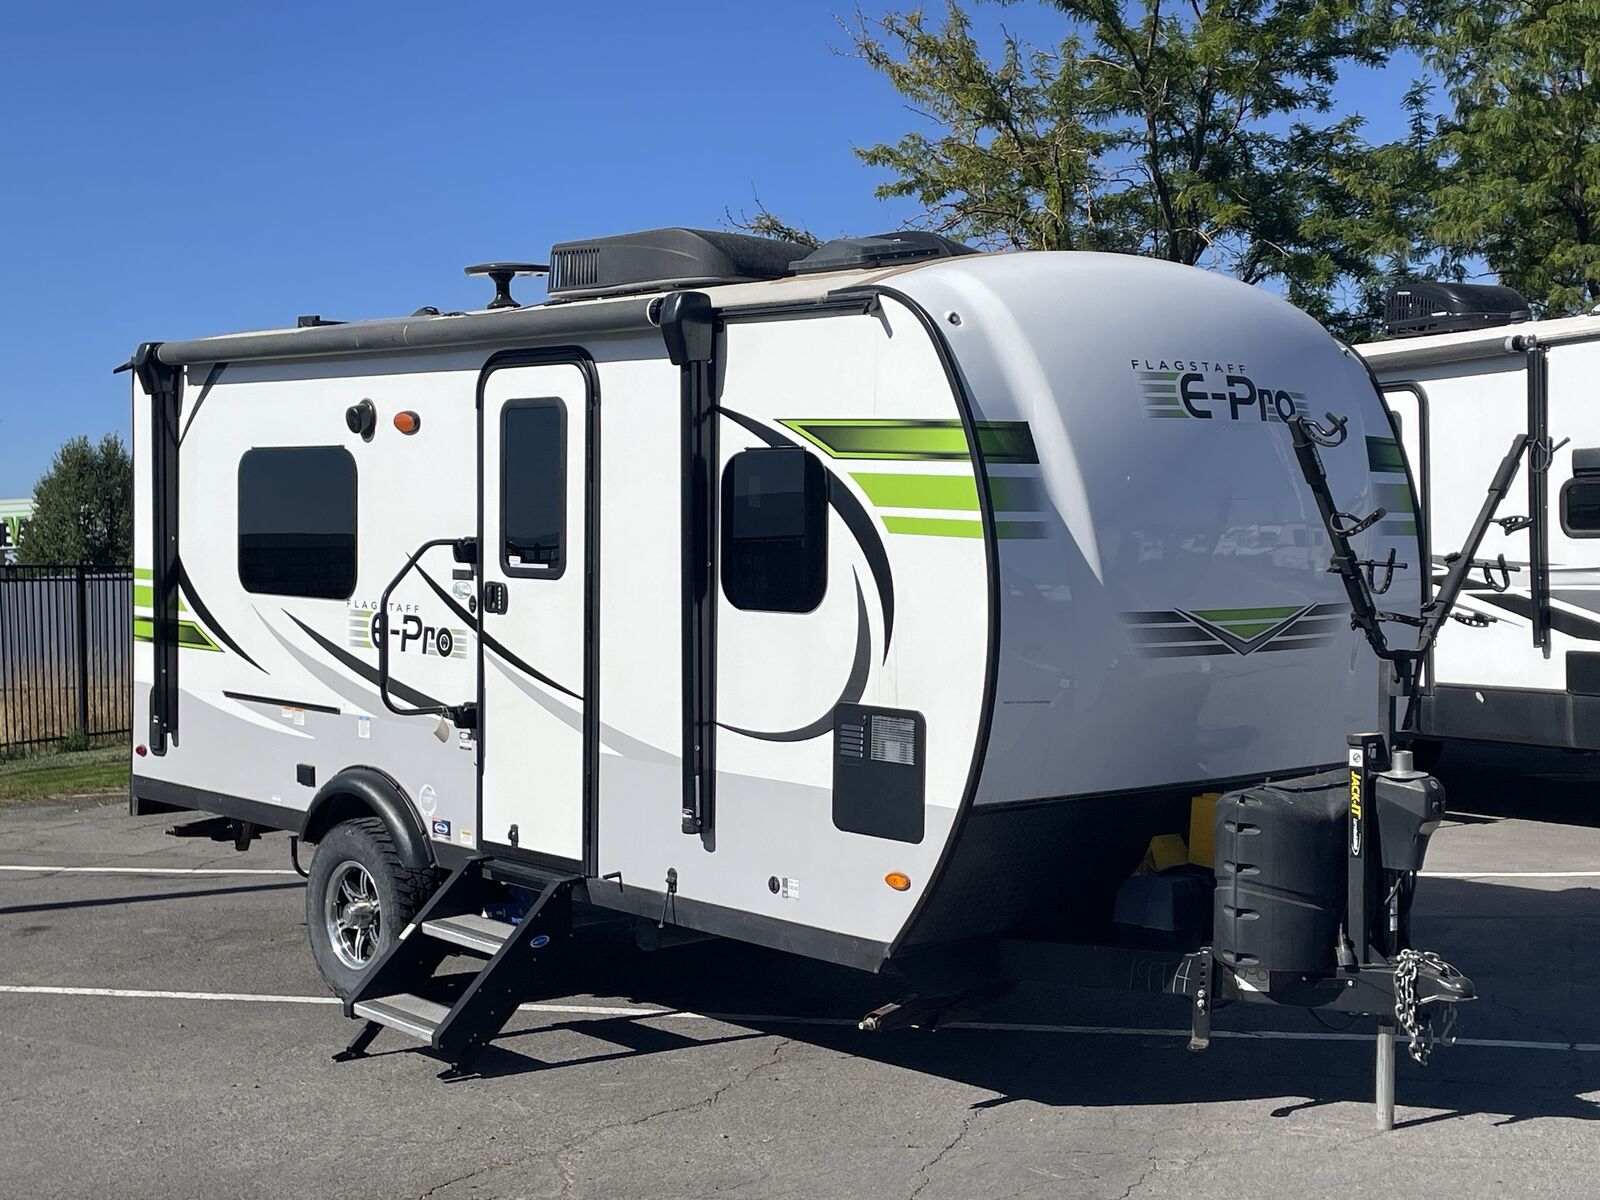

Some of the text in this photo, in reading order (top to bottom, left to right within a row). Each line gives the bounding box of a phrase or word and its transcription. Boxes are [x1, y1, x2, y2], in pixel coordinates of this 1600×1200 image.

[1131, 359, 1246, 374] FLAGSTAFF
[1180, 372, 1296, 423] E-Pro
[346, 600, 420, 613] FLAGTAFF
[1350, 770, 1362, 820] JACK-IT
